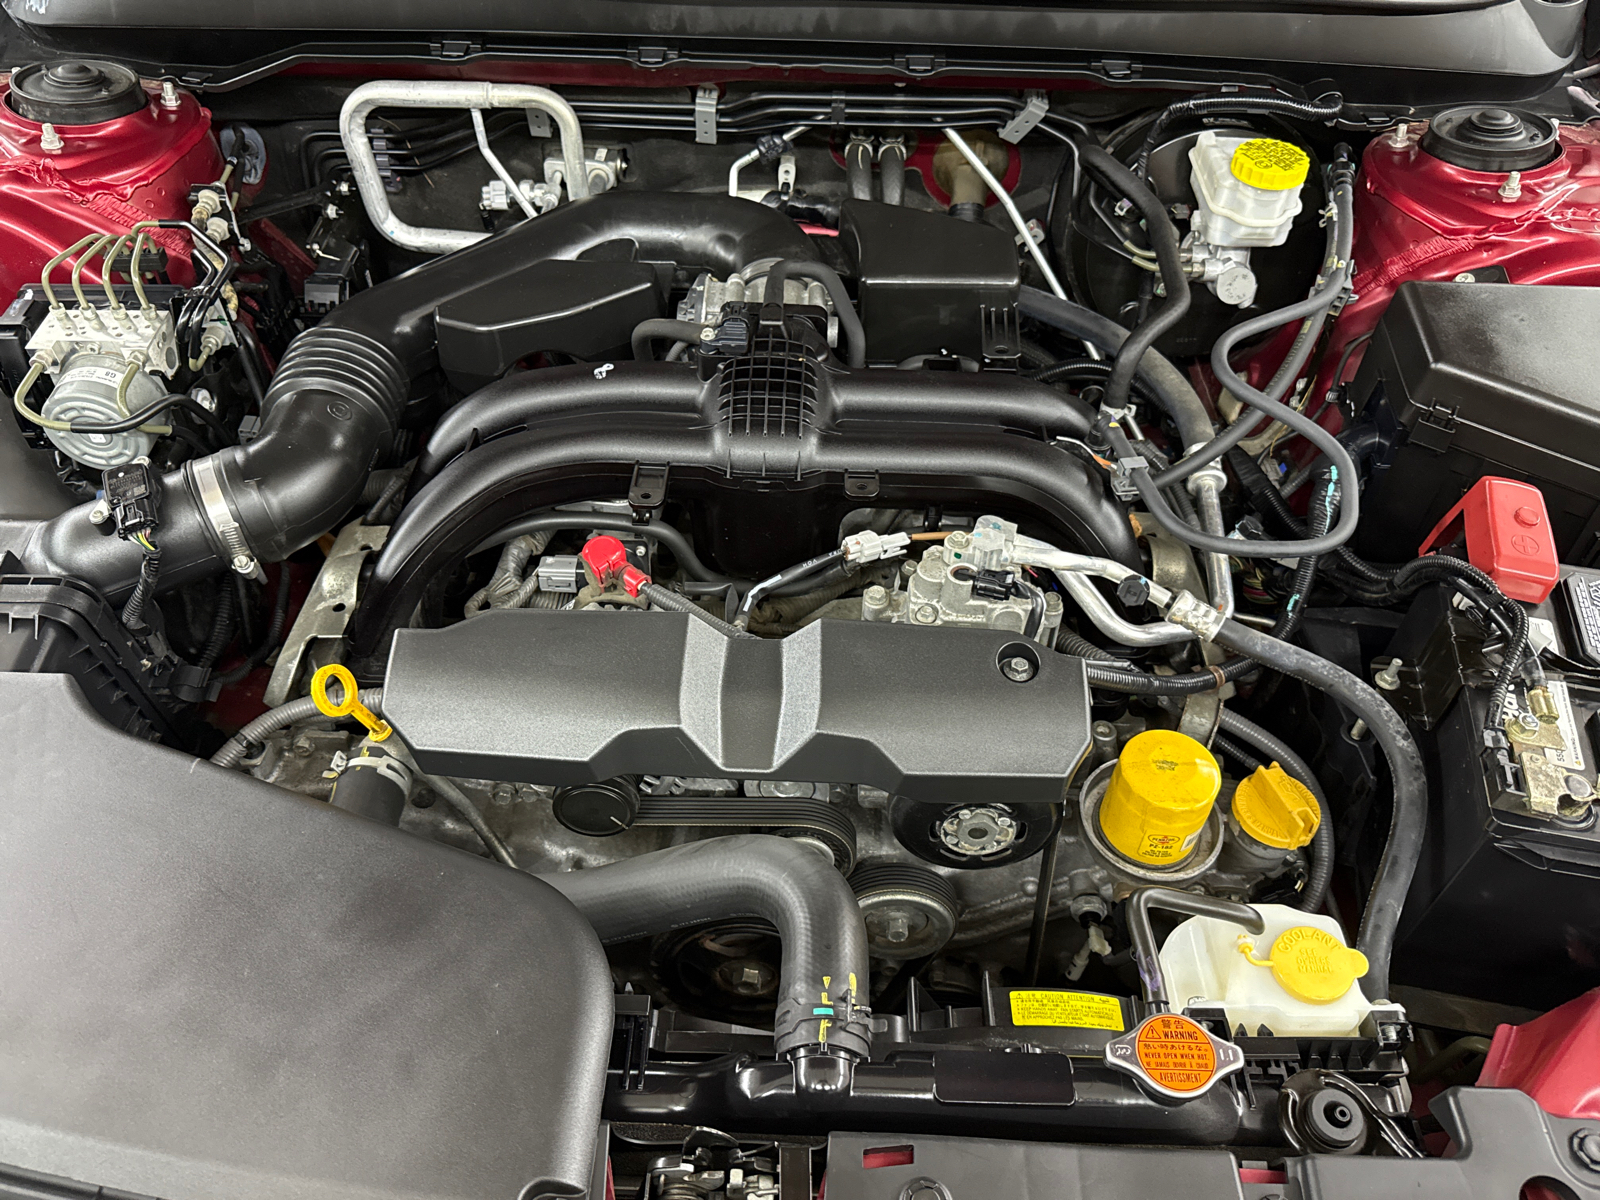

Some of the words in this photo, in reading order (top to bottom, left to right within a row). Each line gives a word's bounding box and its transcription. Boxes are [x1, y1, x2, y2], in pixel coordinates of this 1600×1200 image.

[1277, 928, 1341, 953] COOLANT
[1299, 948, 1318, 957] SEE
[1040, 993, 1064, 1001] CAUTION
[1067, 994, 1095, 1002] ATTENTION
[1161, 1019, 1184, 1029] 警告
[1162, 1031, 1198, 1041] WARNING
[1145, 1052, 1161, 1060] NEVER
[1180, 1053, 1195, 1061] WHEN
